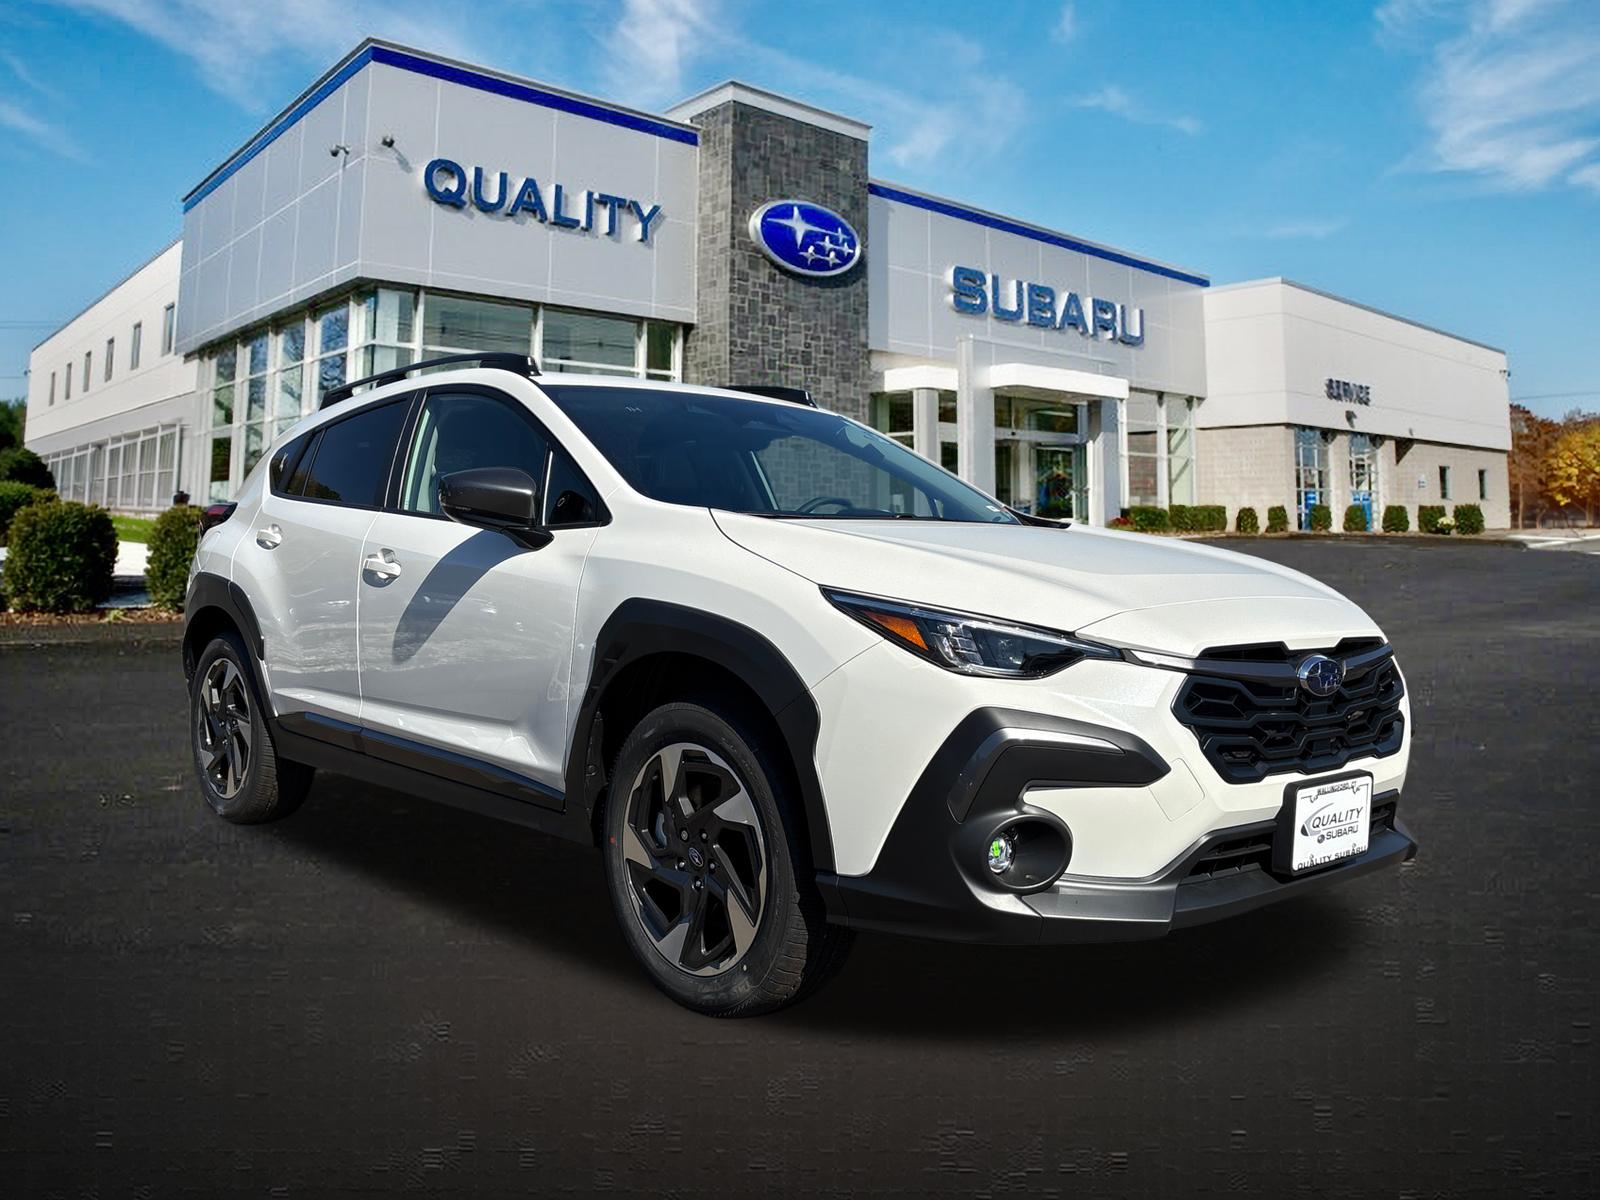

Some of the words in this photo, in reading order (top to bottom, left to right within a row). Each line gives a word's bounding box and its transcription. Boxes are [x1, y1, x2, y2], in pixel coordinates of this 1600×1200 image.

[424, 158, 661, 242] QUALITY
[949, 265, 1144, 346] SUBARU
[1324, 378, 1371, 406] SERVICE
[1312, 806, 1363, 829] QUALITY
[1326, 825, 1359, 840] SUBARU
[1298, 854, 1332, 870] QUALITY
[1335, 845, 1367, 860] SUBARU
